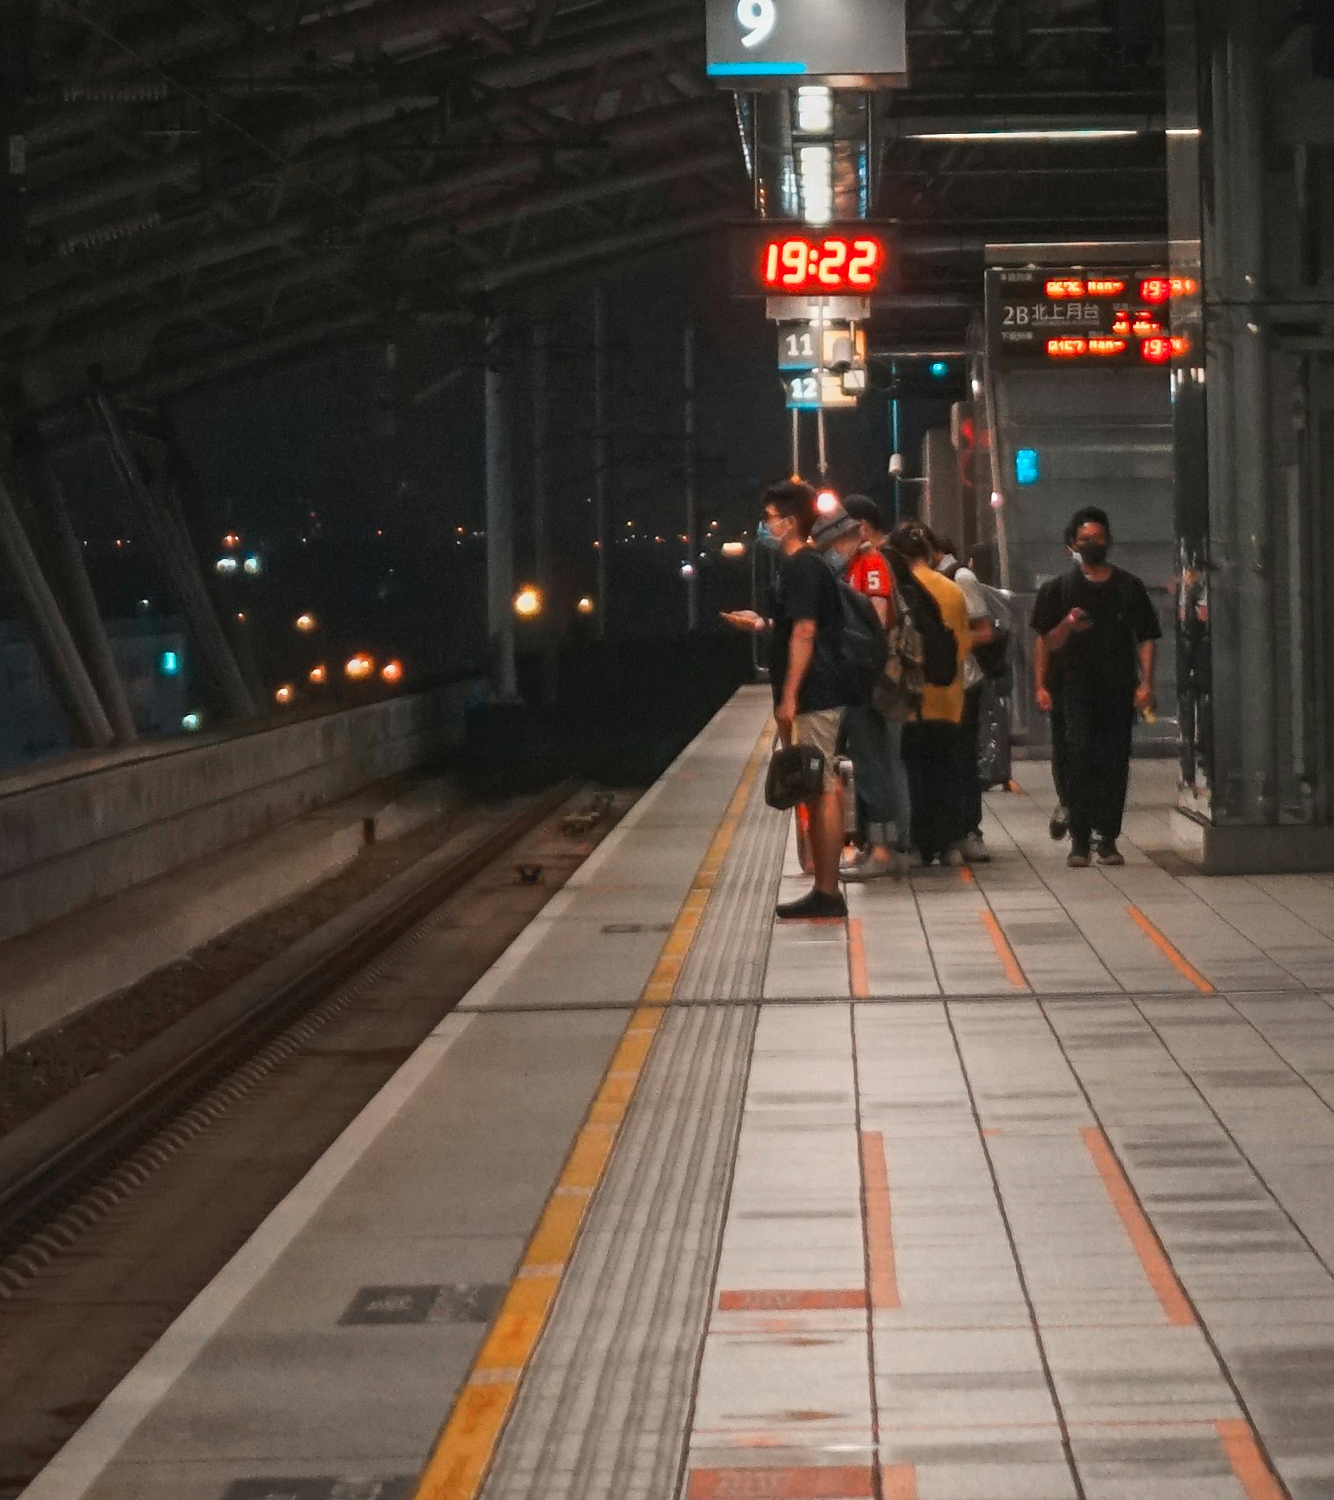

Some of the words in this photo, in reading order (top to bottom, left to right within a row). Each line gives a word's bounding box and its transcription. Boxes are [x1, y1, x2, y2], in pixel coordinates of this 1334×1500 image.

[766, 240, 878, 284] 19:22
[1002, 305, 1029, 326] 2B
[1031, 302, 1100, 321] 北上月台
[786, 333, 814, 357] 11
[790, 377, 818, 399] 12
[867, 569, 880, 590] 5
